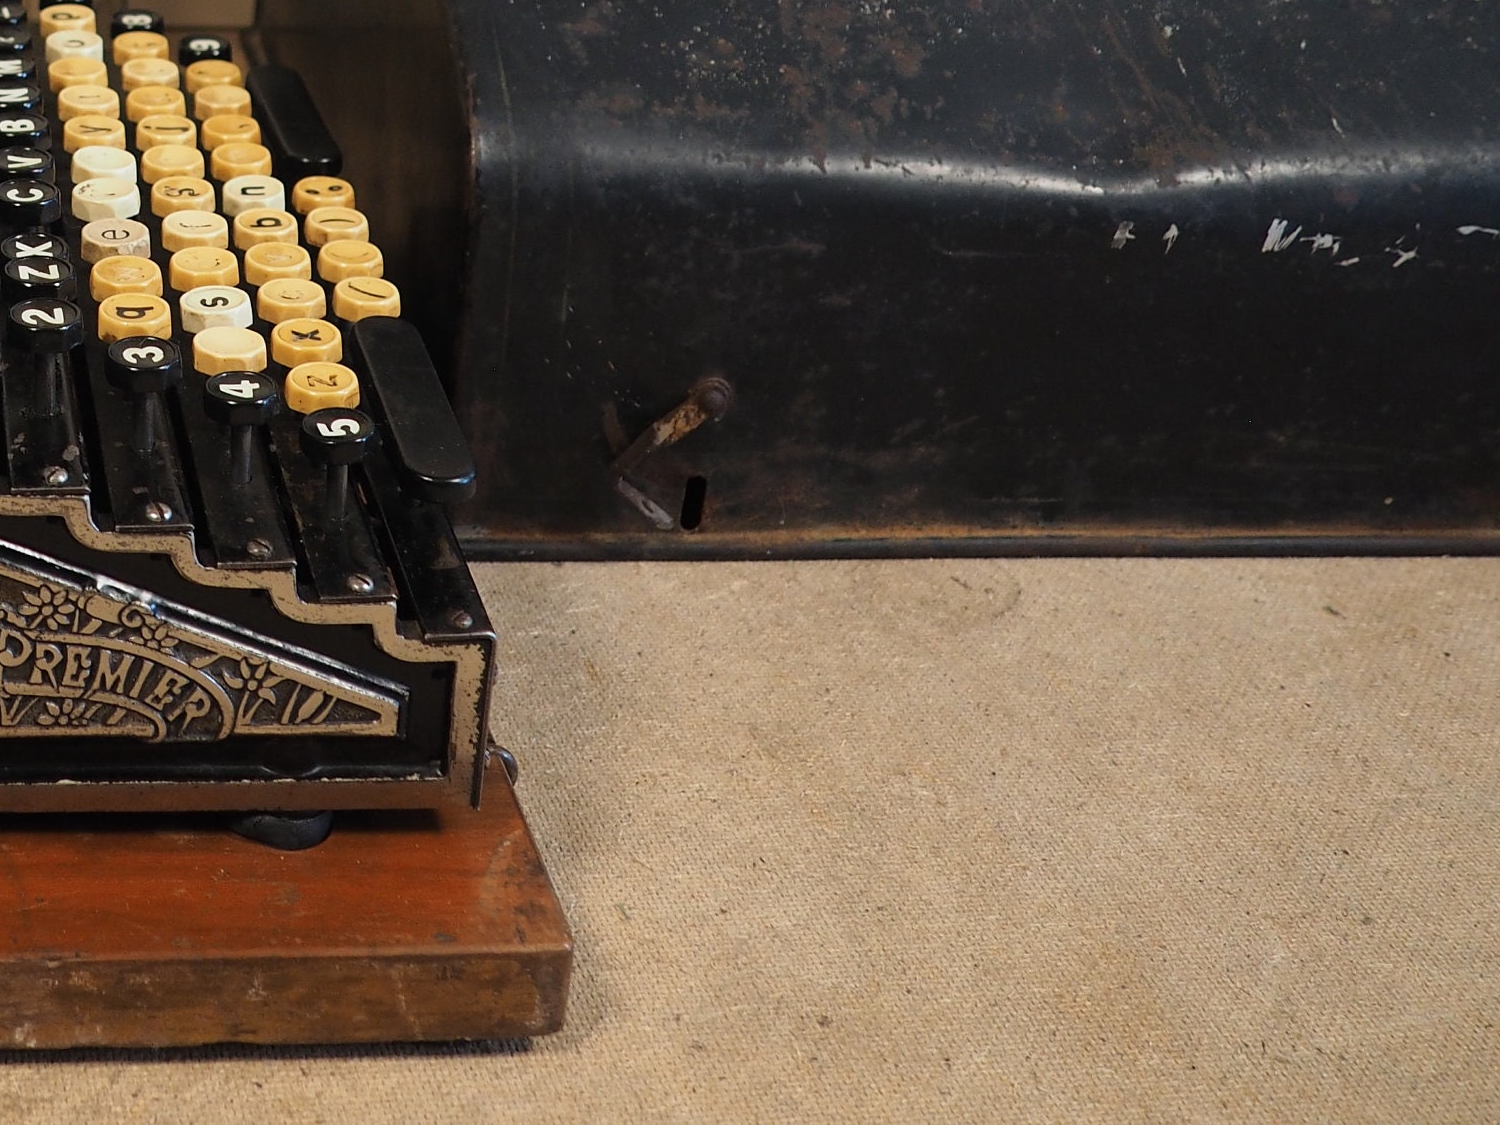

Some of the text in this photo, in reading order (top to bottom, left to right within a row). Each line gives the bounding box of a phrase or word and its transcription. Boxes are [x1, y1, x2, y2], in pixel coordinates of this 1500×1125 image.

[0, 118, 35, 132] B
[6, 155, 43, 169] V
[6, 187, 44, 203] C
[101, 229, 130, 241] e
[15, 240, 53, 258] X
[18, 263, 60, 281] Z
[200, 296, 230, 308] s
[21, 307, 65, 325] 2
[115, 305, 154, 320] q
[122, 345, 165, 364] 3
[219, 379, 261, 399] 4
[316, 418, 361, 438] 5
